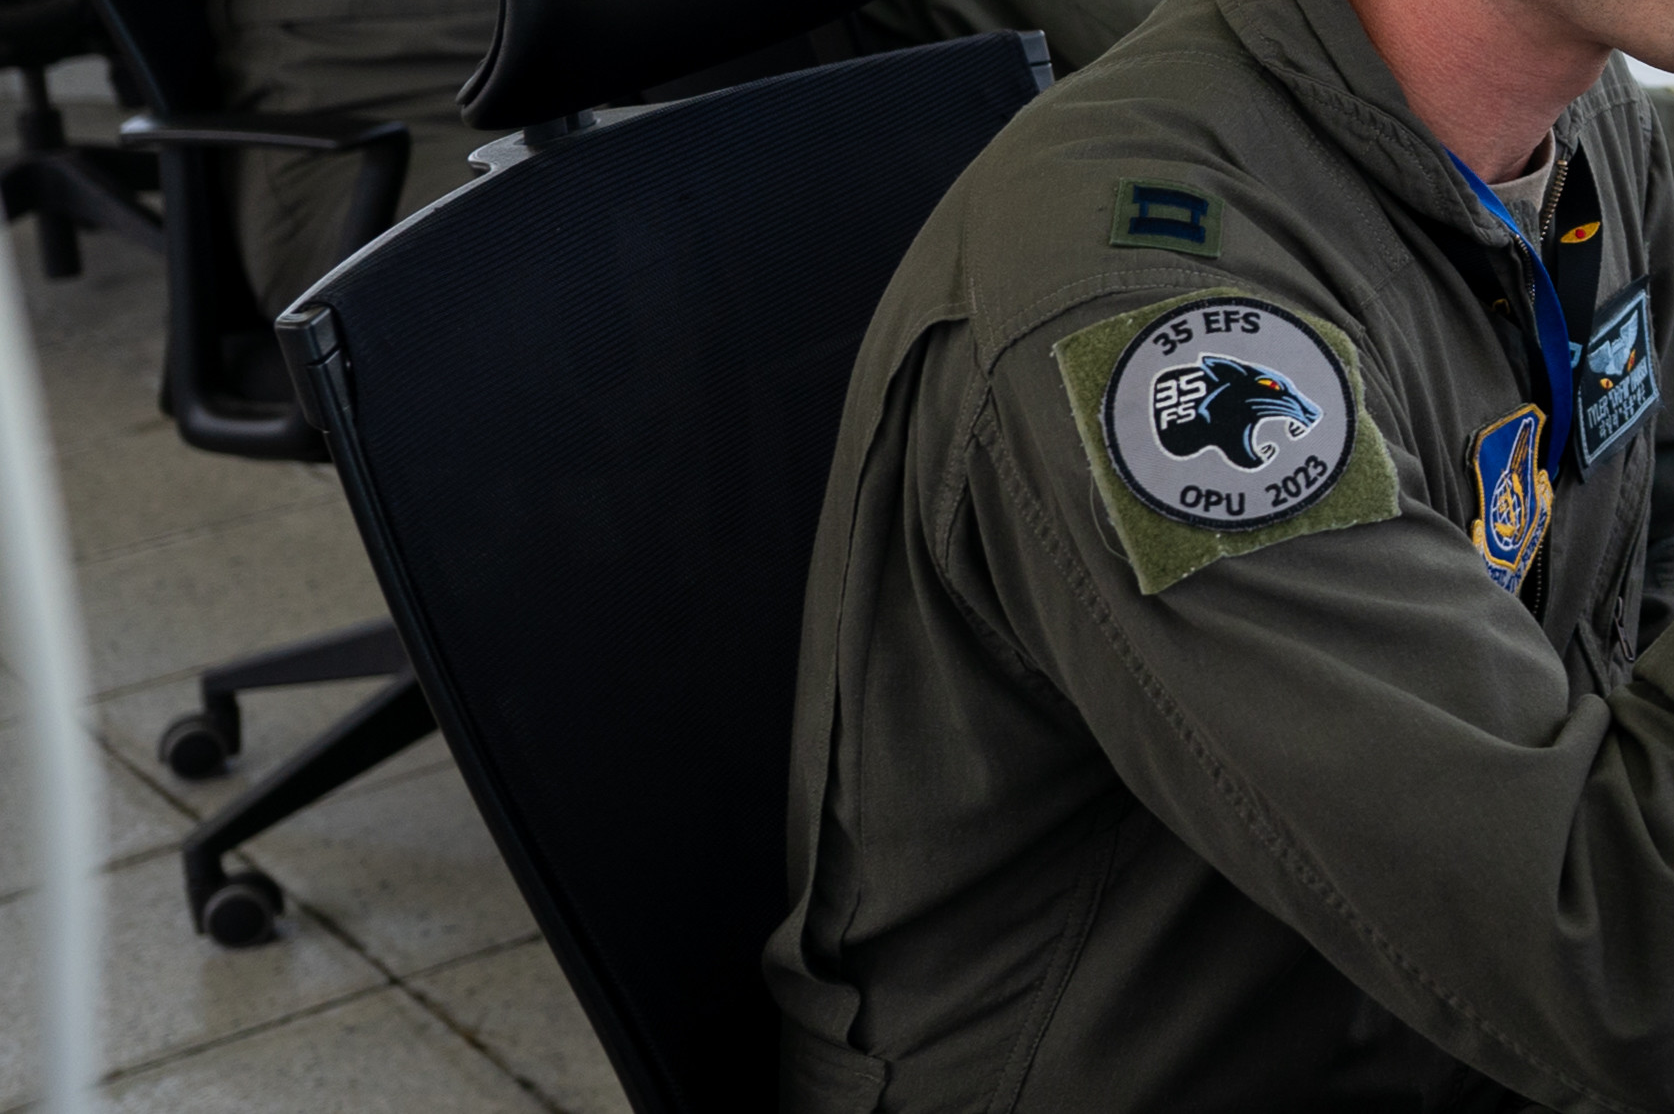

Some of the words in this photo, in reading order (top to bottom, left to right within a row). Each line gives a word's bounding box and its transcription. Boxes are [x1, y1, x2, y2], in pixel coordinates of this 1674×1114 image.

[1152, 319, 1194, 356] 35
[1202, 310, 1261, 335] EFS
[1155, 371, 1207, 408] 35
[1160, 401, 1197, 431] FS
[1179, 483, 1247, 517] OPU
[1265, 453, 1329, 509] 2023
